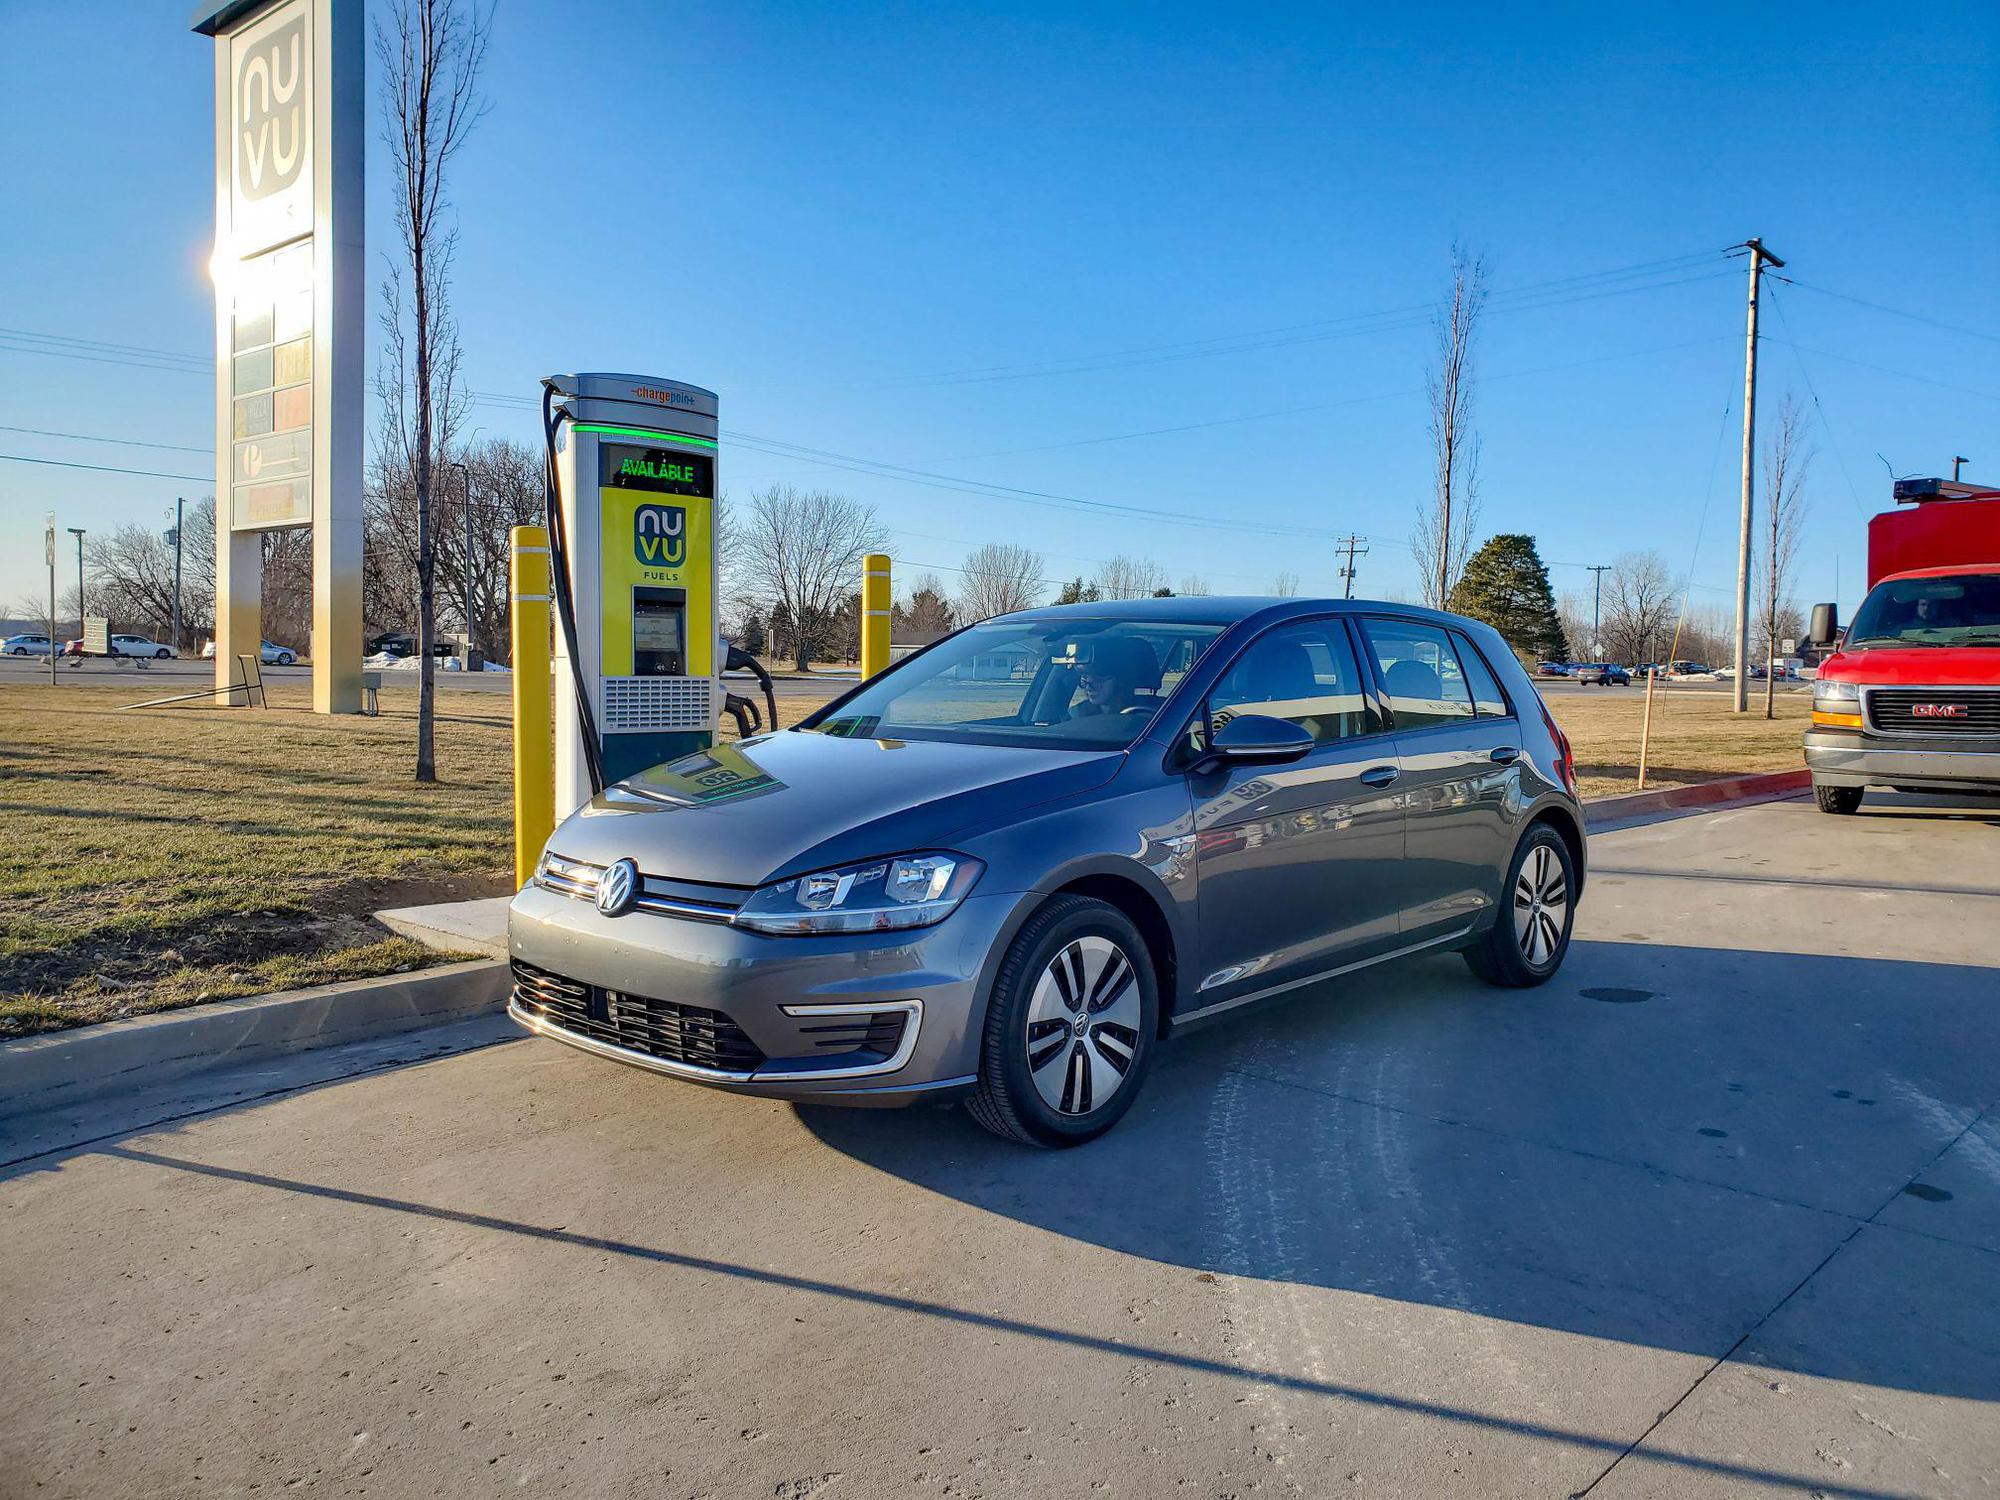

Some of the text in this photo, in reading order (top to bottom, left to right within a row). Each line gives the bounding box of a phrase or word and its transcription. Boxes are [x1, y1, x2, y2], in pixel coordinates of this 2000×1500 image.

[620, 458, 693, 482] AVAILABLE
[644, 571, 679, 581] FUELS
[1912, 703, 1968, 717] GMC
